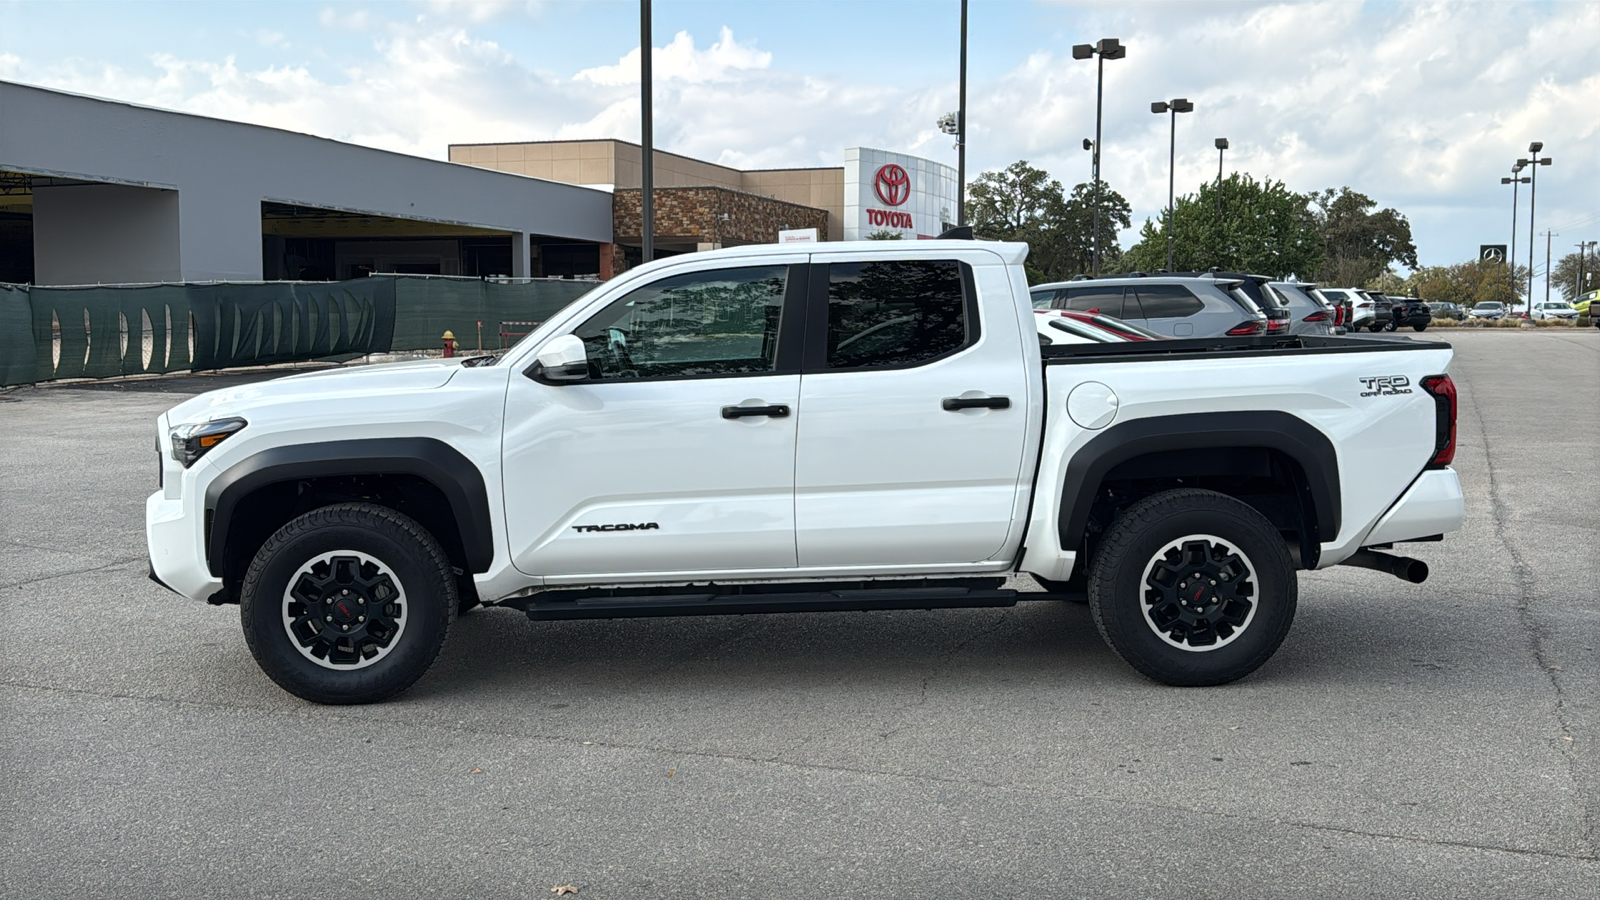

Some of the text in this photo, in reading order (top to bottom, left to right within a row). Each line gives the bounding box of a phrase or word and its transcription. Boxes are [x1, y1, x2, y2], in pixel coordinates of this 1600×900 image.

[866, 208, 913, 229] TOYOTA
[1359, 375, 1410, 391] TRD
[572, 522, 659, 533] TACOMA
